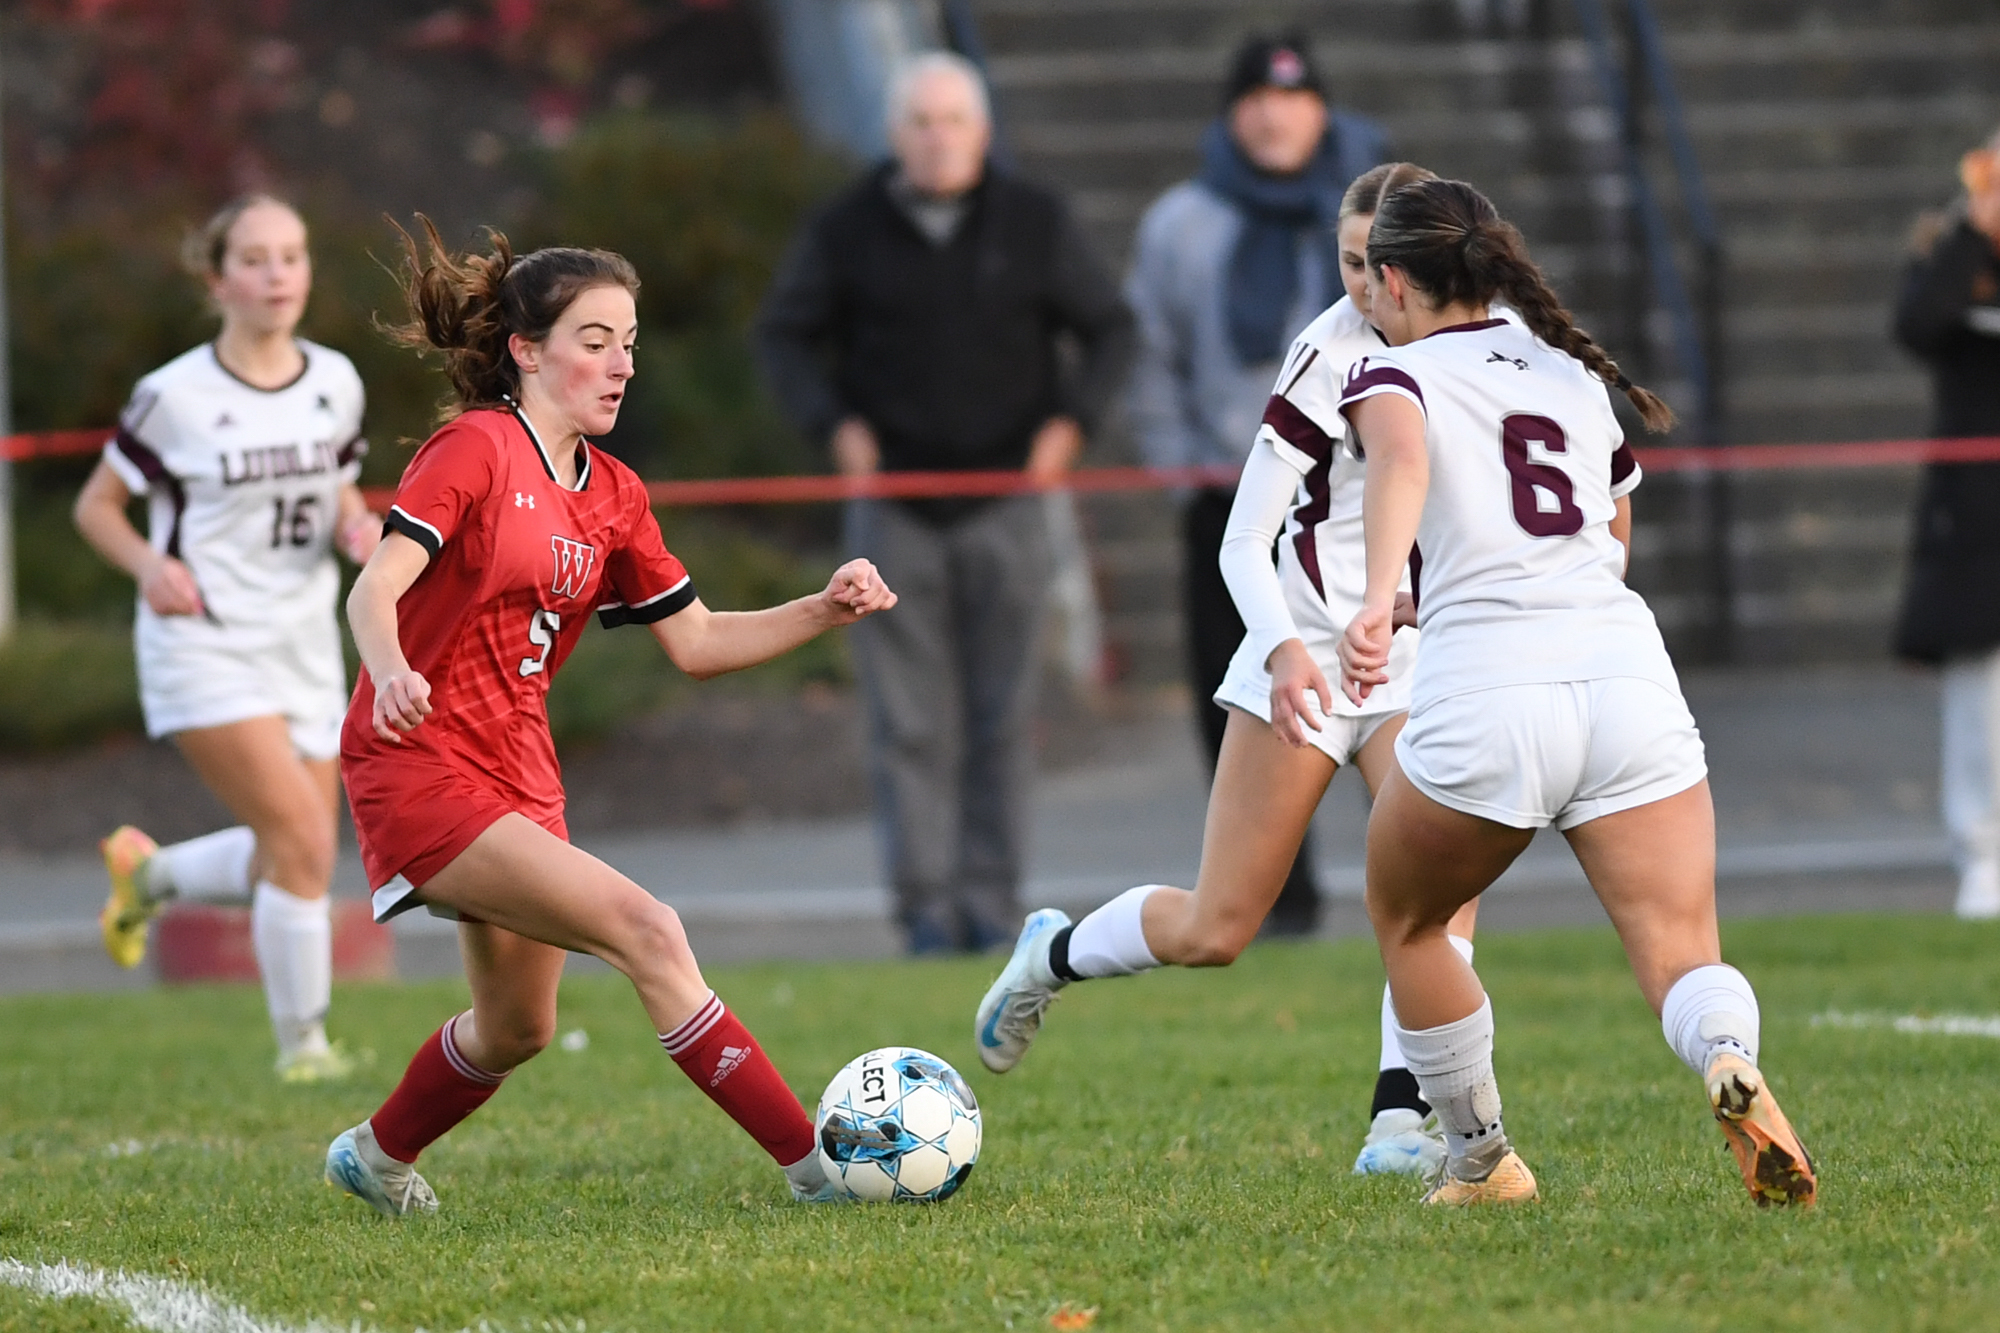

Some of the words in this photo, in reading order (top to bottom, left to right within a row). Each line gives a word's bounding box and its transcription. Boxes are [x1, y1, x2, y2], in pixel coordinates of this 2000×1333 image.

[1500, 410, 1586, 540] 6
[551, 534, 595, 600] W
[518, 608, 560, 678] 5
[710, 1046, 752, 1088] adidas
[863, 1053, 886, 1103] LECT
